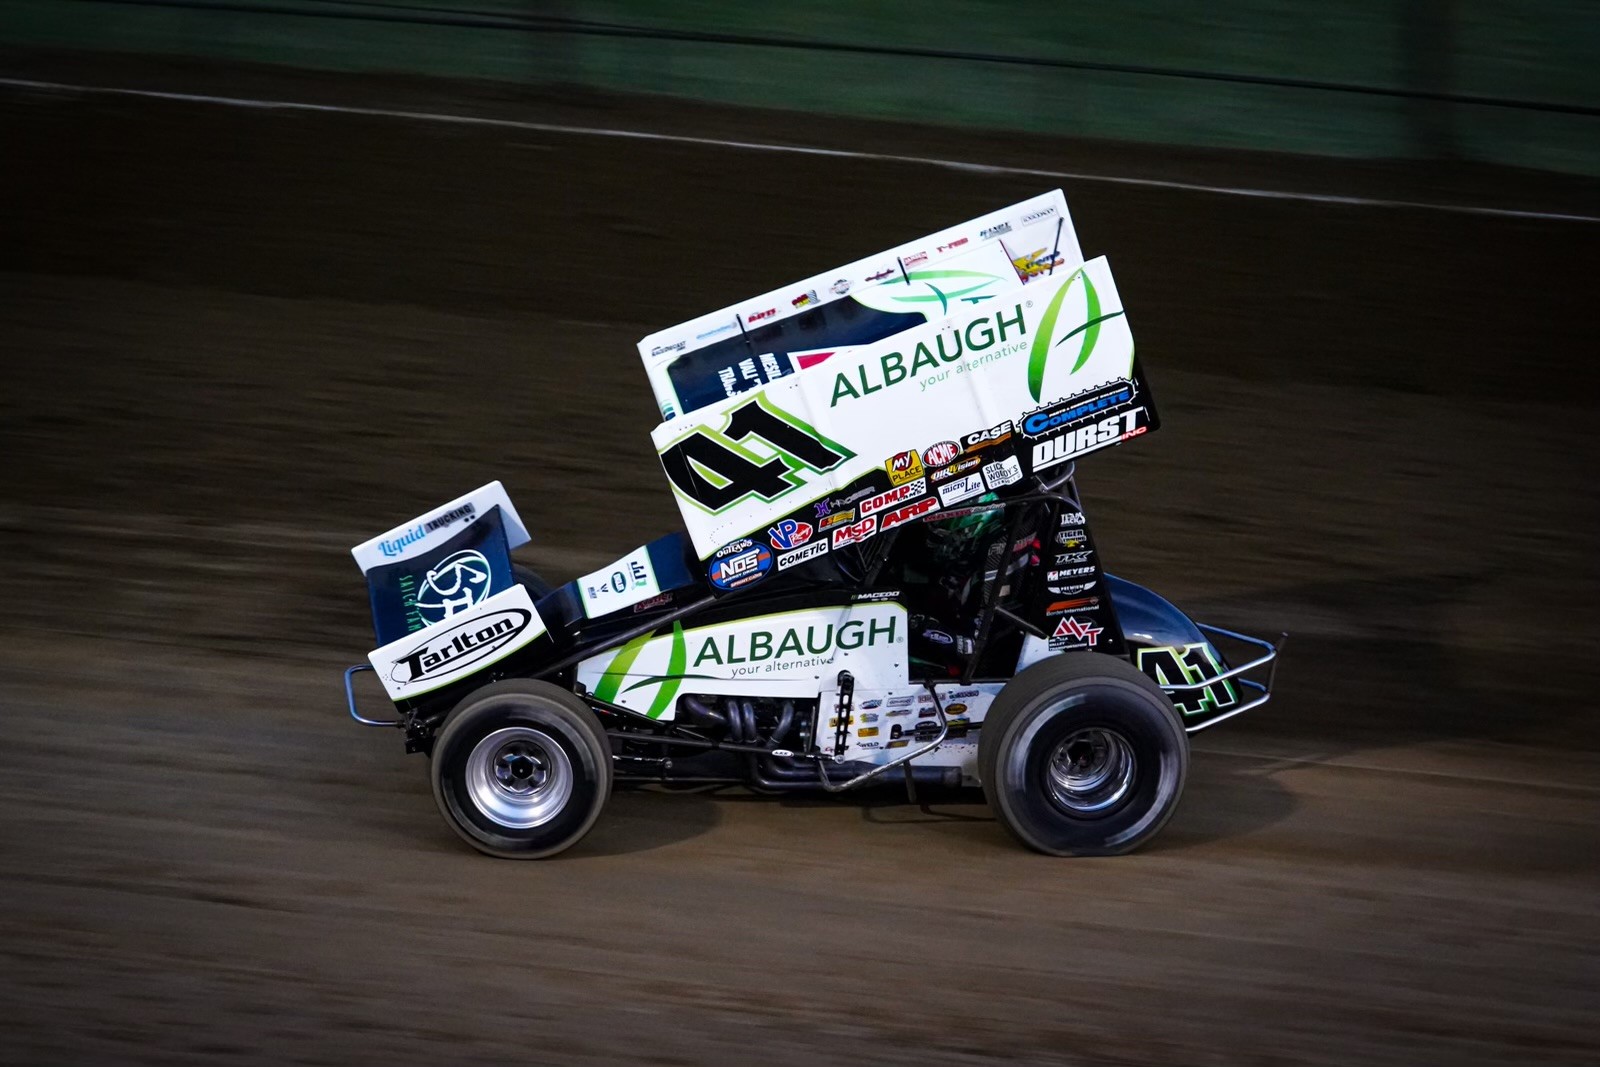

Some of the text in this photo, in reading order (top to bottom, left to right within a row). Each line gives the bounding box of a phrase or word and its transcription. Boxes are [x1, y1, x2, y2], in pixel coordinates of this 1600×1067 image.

[759, 353, 782, 380] MESIL
[830, 304, 1027, 408] ALBAUGH
[919, 341, 1028, 391] your alternative
[1025, 390, 1130, 433] COMPLETE
[967, 421, 1012, 445] CASE
[1032, 406, 1144, 468] DURST
[1121, 426, 1147, 440] INC
[659, 395, 850, 513] 41
[892, 452, 912, 472] MY
[927, 444, 956, 466] ACME
[892, 465, 922, 482] PLACE
[985, 461, 1004, 476] SLICK
[861, 486, 911, 513] COMP
[881, 497, 937, 530] ARP
[378, 502, 472, 556] Liquid TRUCKING
[768, 519, 797, 549] VP
[834, 518, 875, 543] MSD
[716, 540, 753, 558] OUTLAWS
[780, 542, 827, 567] COMETIC
[720, 548, 760, 579] NOS
[1059, 566, 1096, 576] MEYERS
[857, 591, 900, 599] MACEDO
[1064, 605, 1100, 614] International
[392, 617, 514, 684] Tarlton
[693, 616, 897, 668] ALBAUGH
[731, 655, 834, 679] your alternative
[1138, 642, 1238, 715] 41
